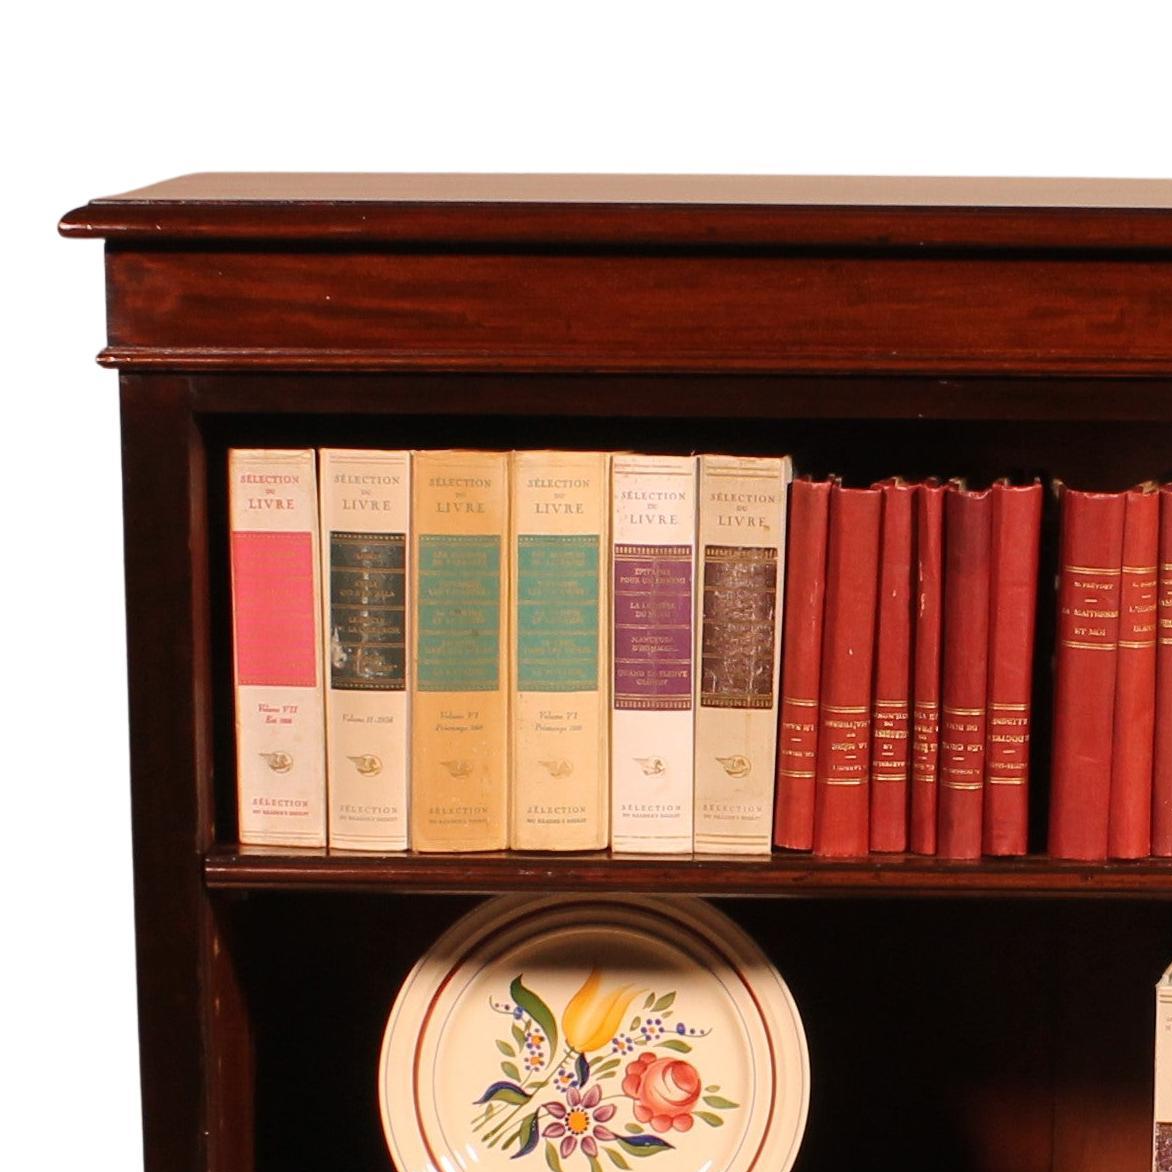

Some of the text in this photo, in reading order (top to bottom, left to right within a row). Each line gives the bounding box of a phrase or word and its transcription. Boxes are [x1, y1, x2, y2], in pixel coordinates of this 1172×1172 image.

[248, 499, 295, 510] LIVRE
[342, 499, 392, 511] LIVRE
[435, 502, 486, 513] LIVRE
[535, 503, 584, 514] LIVRE
[629, 514, 679, 526] LIVRE
[717, 514, 765, 527] LIVRE
